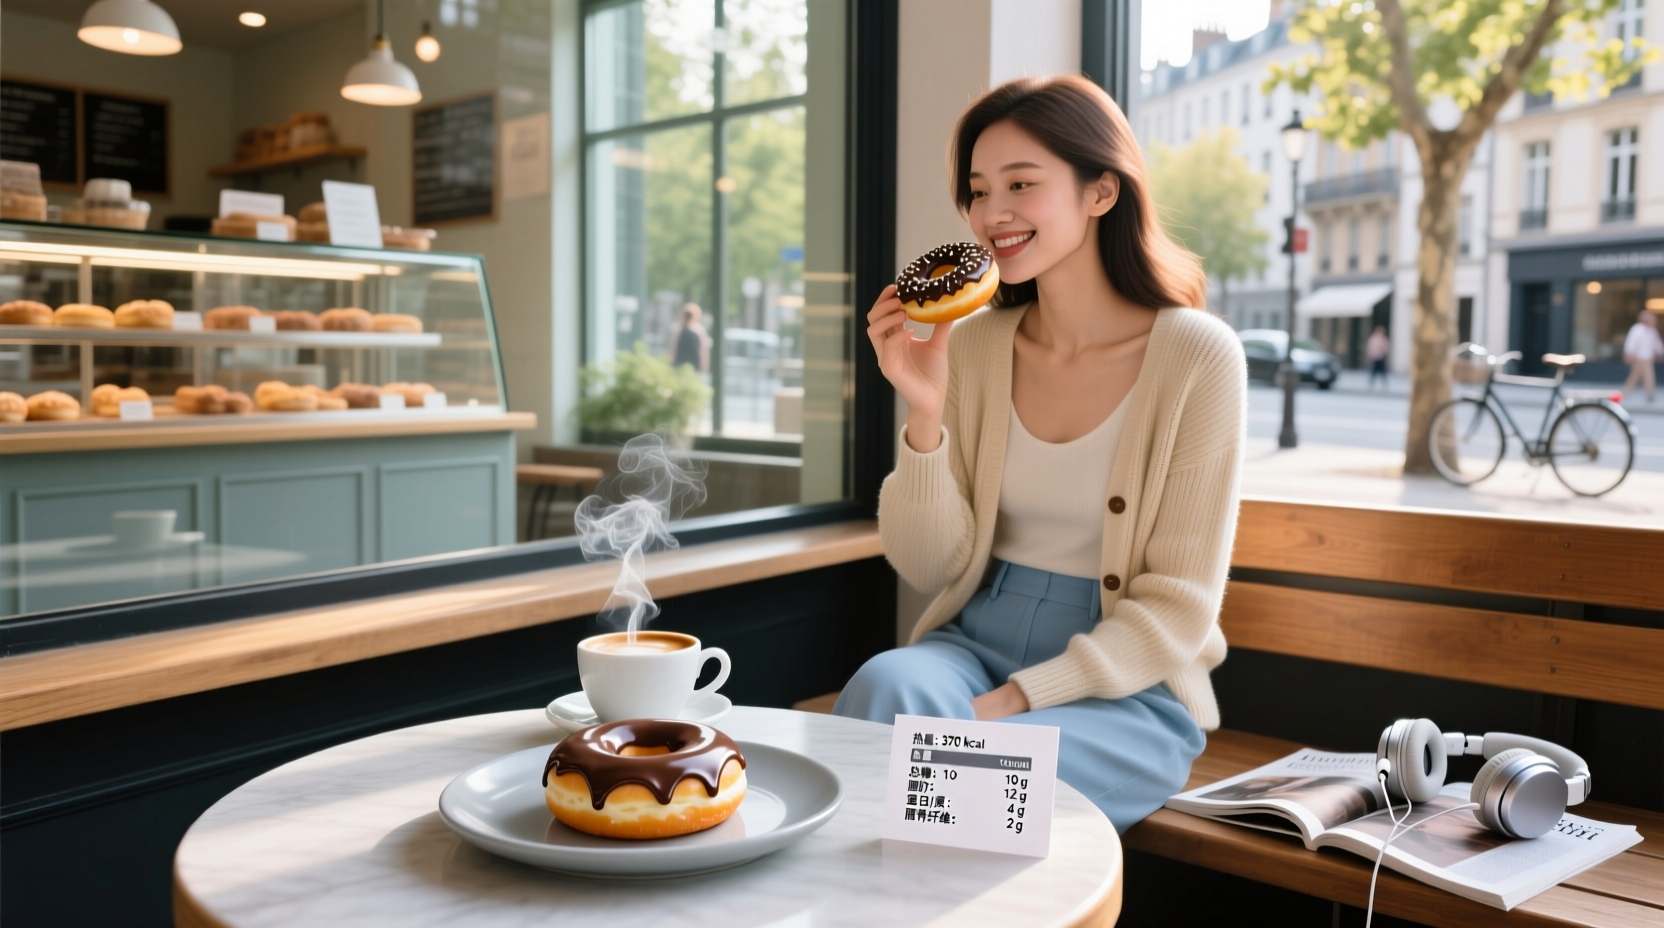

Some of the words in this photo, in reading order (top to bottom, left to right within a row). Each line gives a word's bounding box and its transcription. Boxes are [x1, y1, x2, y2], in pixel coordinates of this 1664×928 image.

[941, 735, 961, 747] 370
[963, 736, 985, 749] kcal
[944, 769, 957, 780] 10
[1005, 774, 1019, 785] 10
[1020, 779, 1028, 789] g
[1004, 788, 1017, 800] 12
[1019, 793, 1027, 803] g
[1007, 803, 1014, 813] 4
[1017, 807, 1025, 818] g
[1006, 817, 1014, 828] 2
[1015, 821, 1023, 834] g
